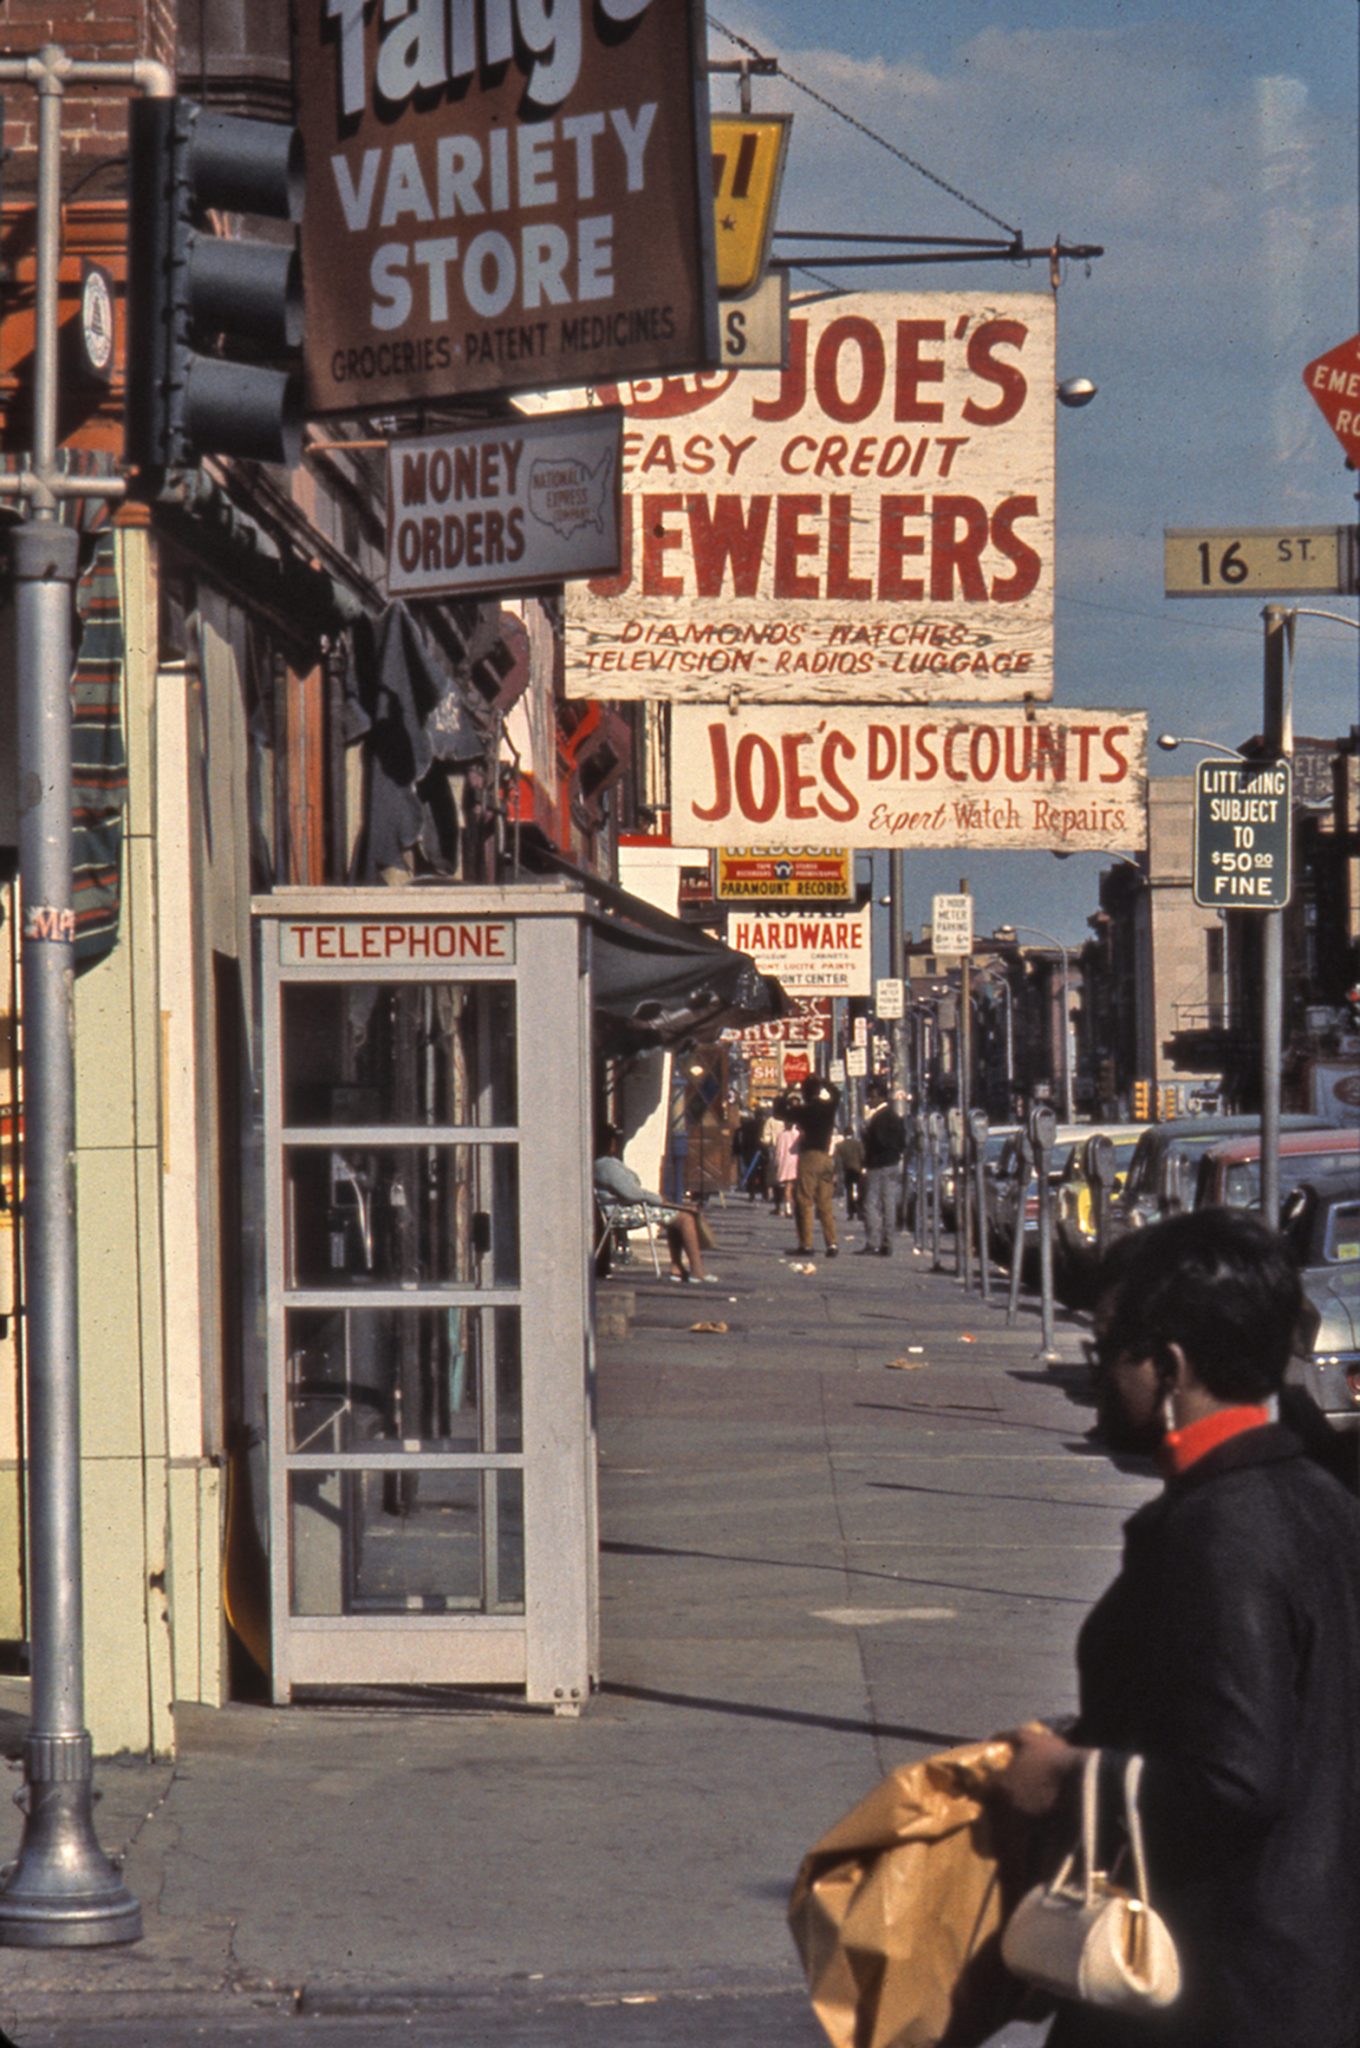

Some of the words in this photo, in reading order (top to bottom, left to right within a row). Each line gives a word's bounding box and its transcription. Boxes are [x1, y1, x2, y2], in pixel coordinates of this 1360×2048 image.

[331, 102, 658, 232] VARIETY
[370, 214, 615, 332] STORE
[331, 338, 452, 382] GROCERIES
[465, 321, 548, 365] PATENT
[560, 306, 676, 354] MEDICINES
[752, 315, 1030, 427] JOE'S
[402, 439, 524, 507] MONEY
[622, 433, 757, 476] EASY
[780, 434, 970, 478] CREDIT
[397, 507, 526, 574] ORDERS
[587, 493, 1041, 602] JEWELERS
[1198, 541, 1249, 585] 16
[1277, 538, 1316, 562] ST.
[618, 621, 806, 647] DIAMONDS
[828, 623, 968, 647] WATCHES
[584, 648, 756, 673] TELEVISION
[774, 650, 873, 674] RADIOS
[891, 651, 1034, 674] LUGGAGE
[691, 721, 860, 824] JOE'S
[867, 723, 1130, 784] DISCOUNTS
[868, 802, 947, 835] Expert
[952, 798, 1021, 831] Watch
[1032, 799, 1126, 837] Repairs
[1210, 798, 1278, 823] SUBJECT
[1233, 826, 1255, 849] TO
[720, 881, 791, 896] PARAMOUNT
[797, 881, 848, 896] RECORDS
[1214, 876, 1273, 897] FINE
[290, 924, 505, 959] TELEPHONE
[736, 923, 862, 950] HARDWARE
[805, 973, 849, 985] CENTER
